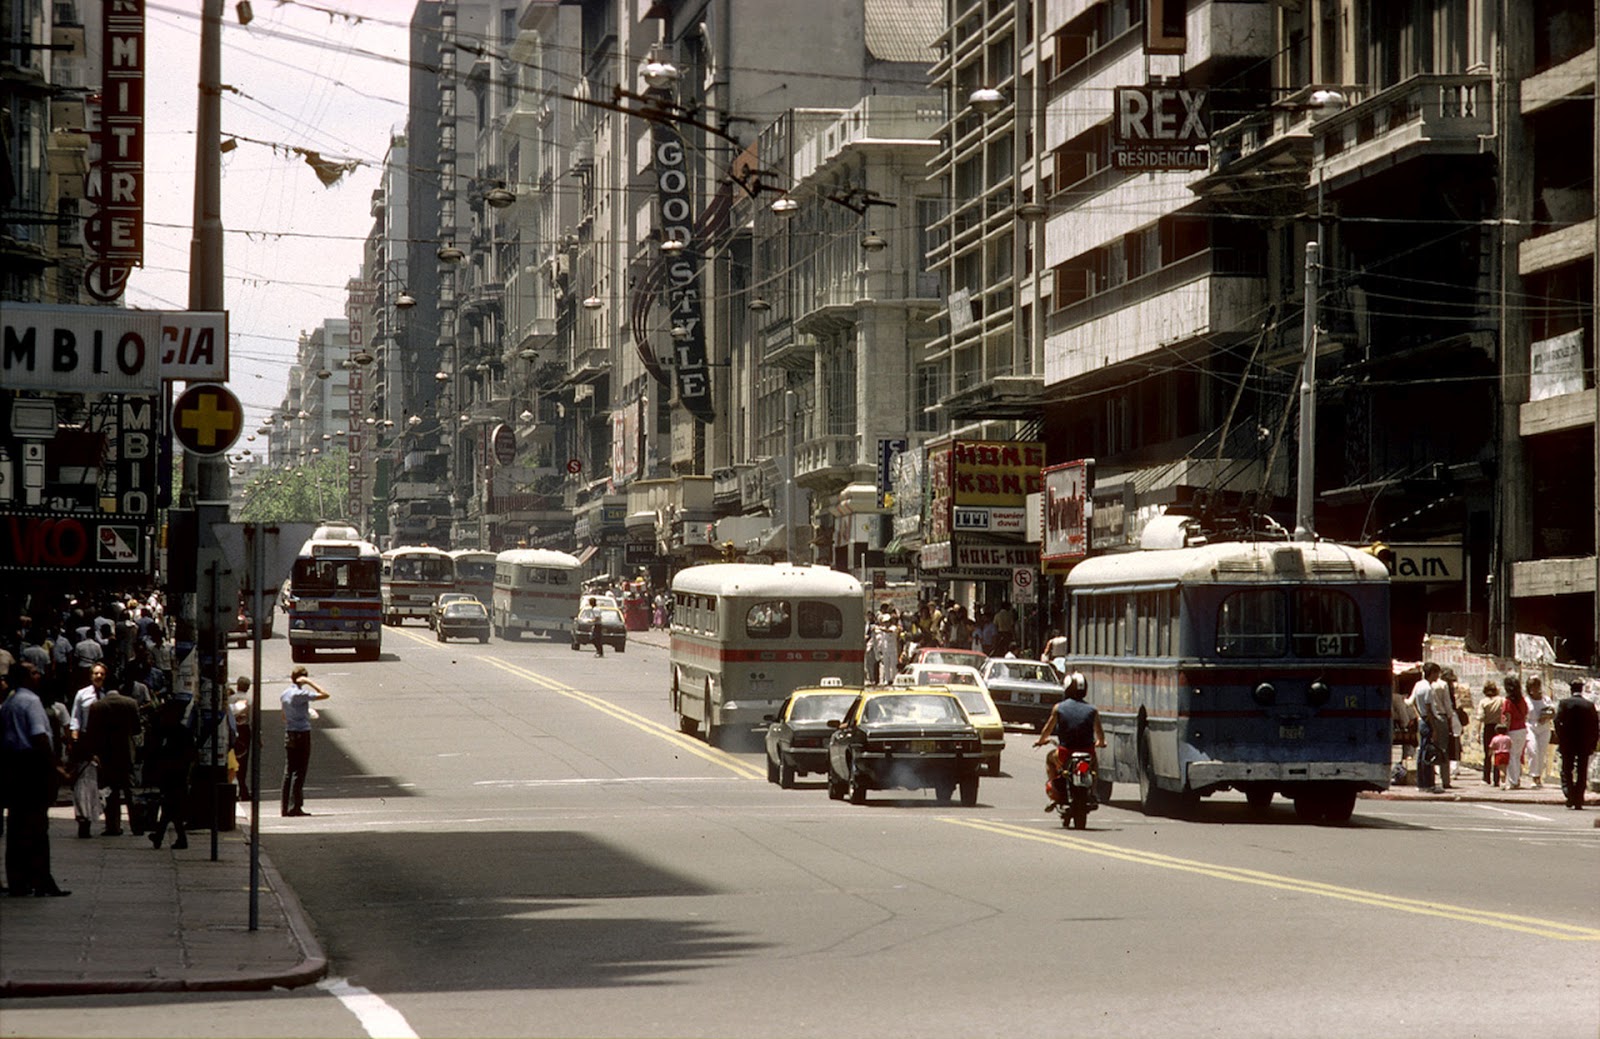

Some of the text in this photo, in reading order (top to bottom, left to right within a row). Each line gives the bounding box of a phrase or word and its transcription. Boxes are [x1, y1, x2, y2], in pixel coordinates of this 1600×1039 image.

[1120, 89, 1208, 139] REX
[111, 36, 138, 248] MITRE
[1119, 152, 1206, 167] RESIDENCIAL
[3, 326, 146, 375] MBIO
[162, 326, 214, 365] CIA
[122, 402, 150, 514] MBIO
[956, 442, 1042, 467] HONG
[957, 473, 1041, 494] KONG
[957, 511, 987, 526] ITT
[1318, 637, 1339, 653] 64
